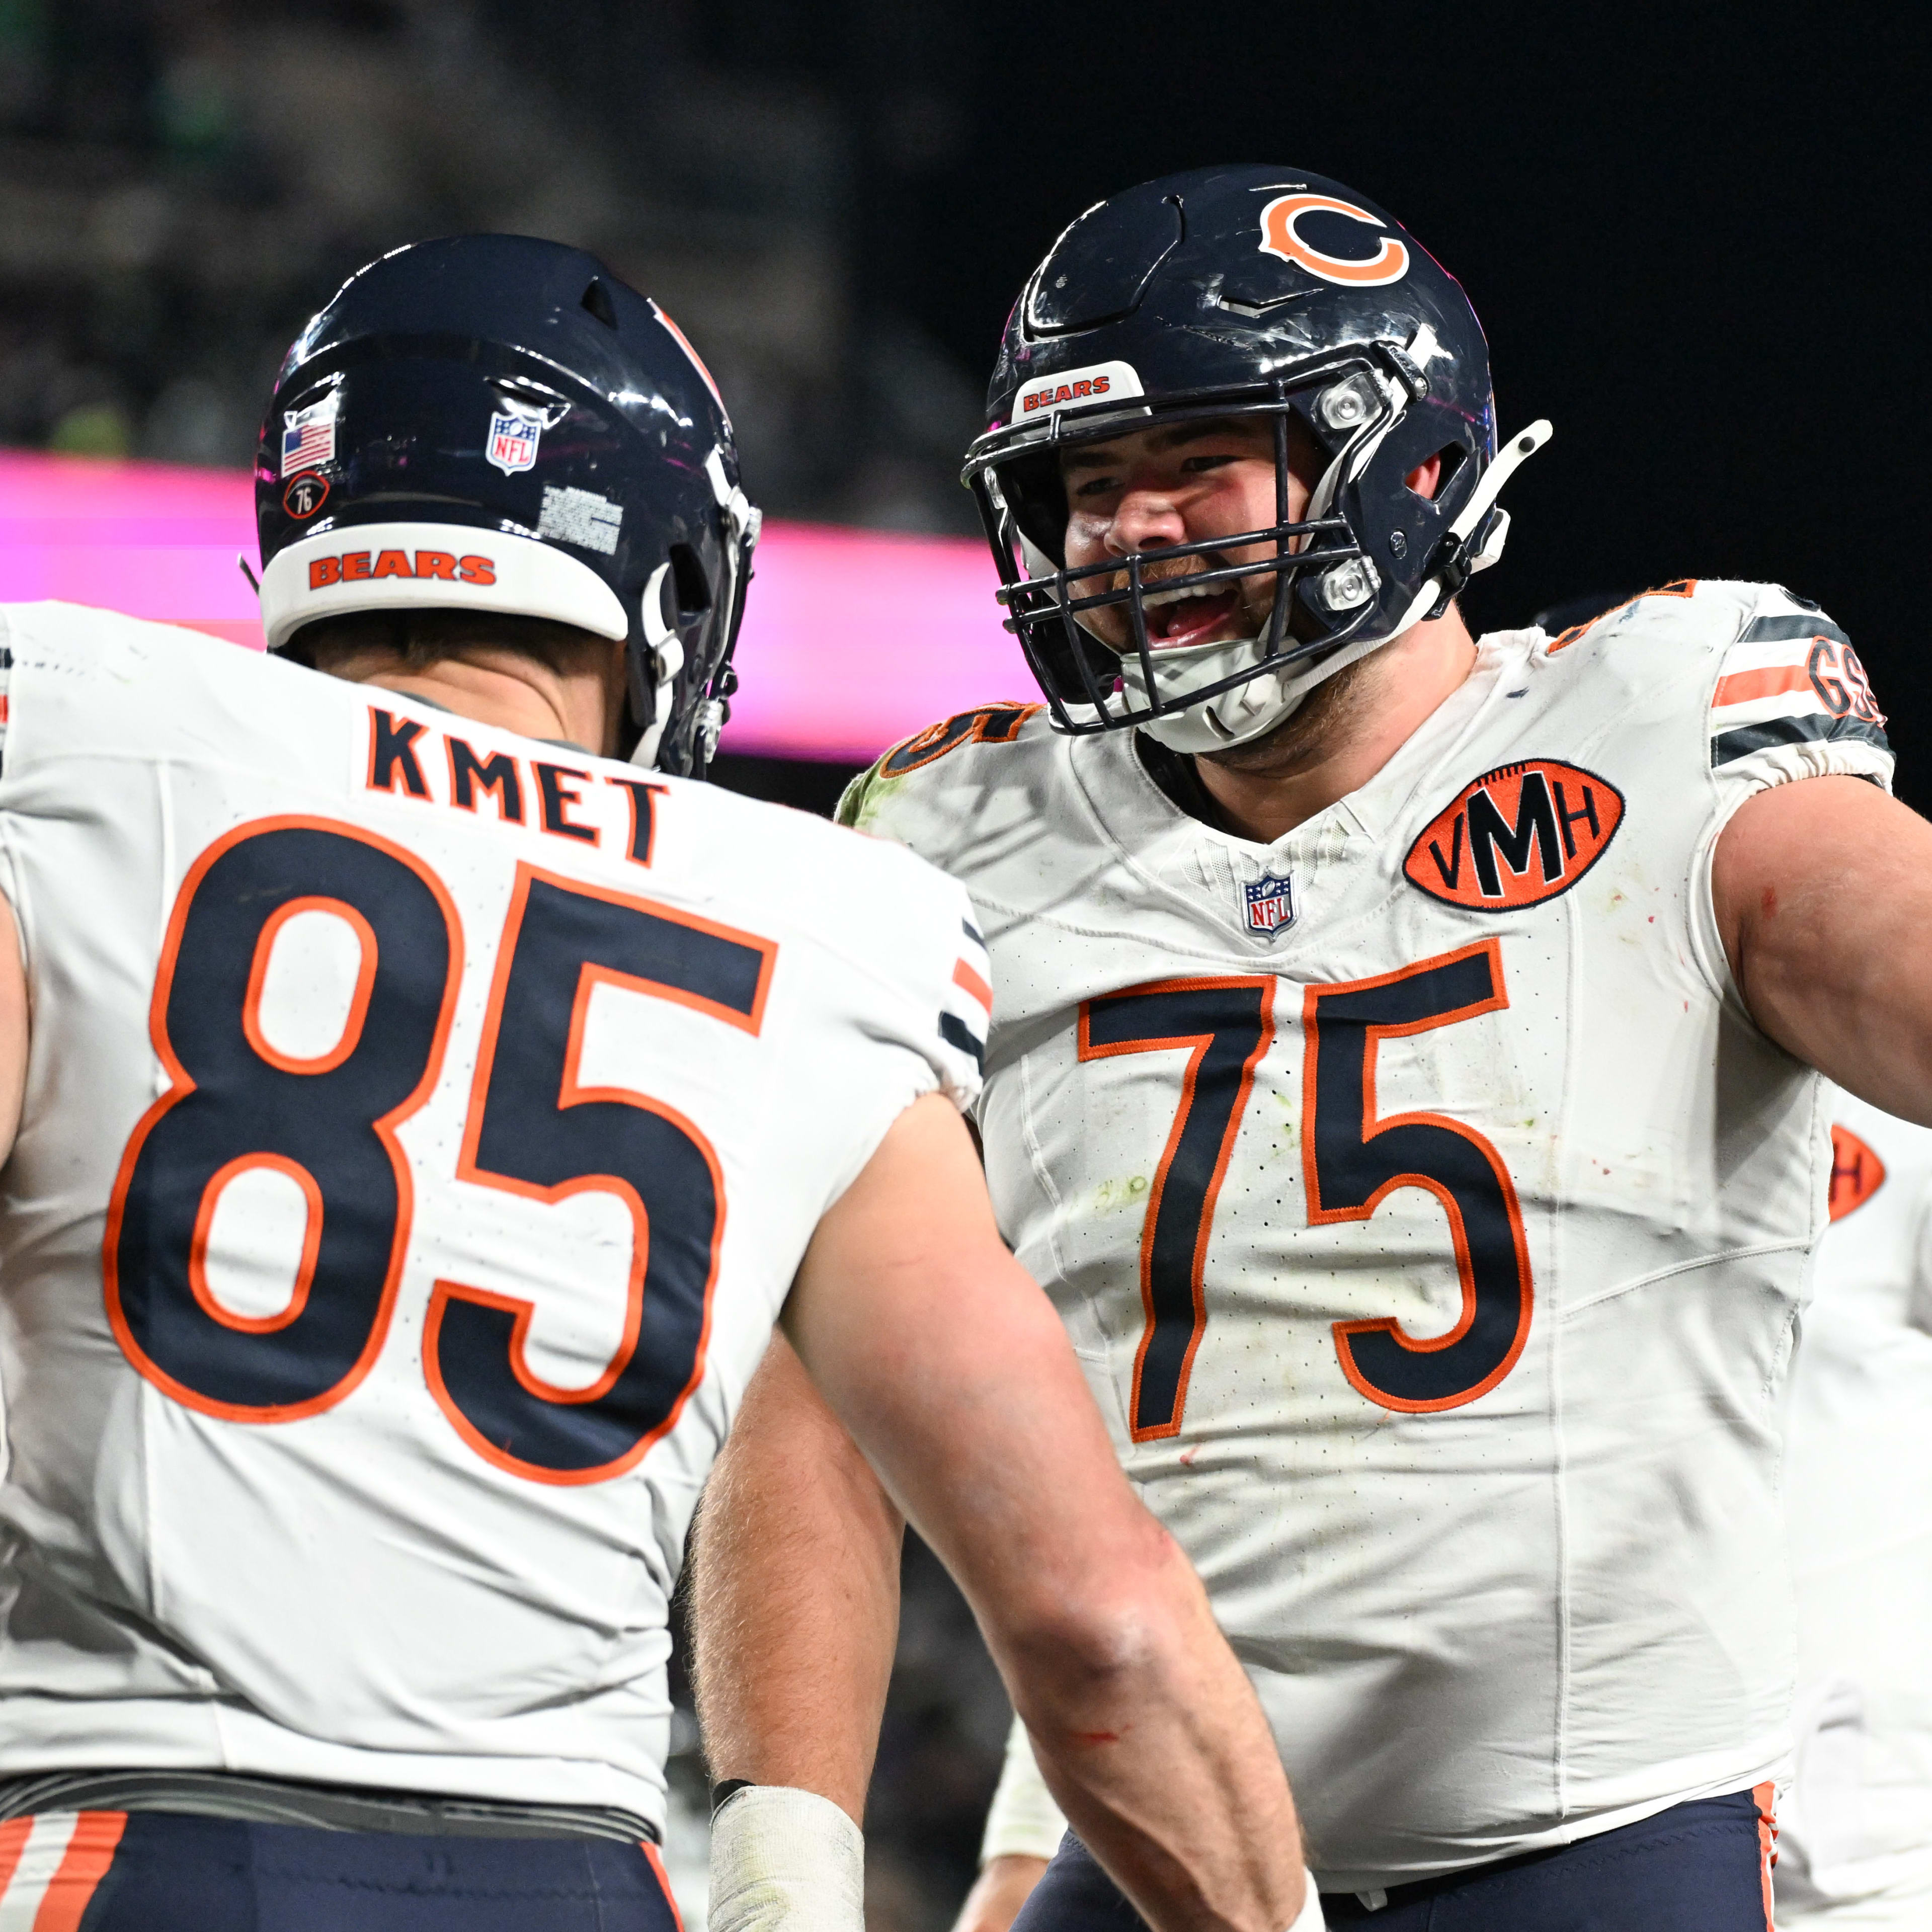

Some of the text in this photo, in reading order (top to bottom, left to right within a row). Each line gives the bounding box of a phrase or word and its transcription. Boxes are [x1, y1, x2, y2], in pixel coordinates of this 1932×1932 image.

[1258, 193, 1410, 287] C
[1023, 376, 1111, 413] BEARS
[494, 435, 531, 463] NFL
[296, 487, 312, 514] 76
[309, 549, 497, 591] BEARS
[366, 705, 671, 869] KMET
[1428, 770, 1600, 898] VMH
[1251, 897, 1292, 927] NFL
[103, 814, 779, 1485] 85
[1078, 937, 1534, 1443] 75
